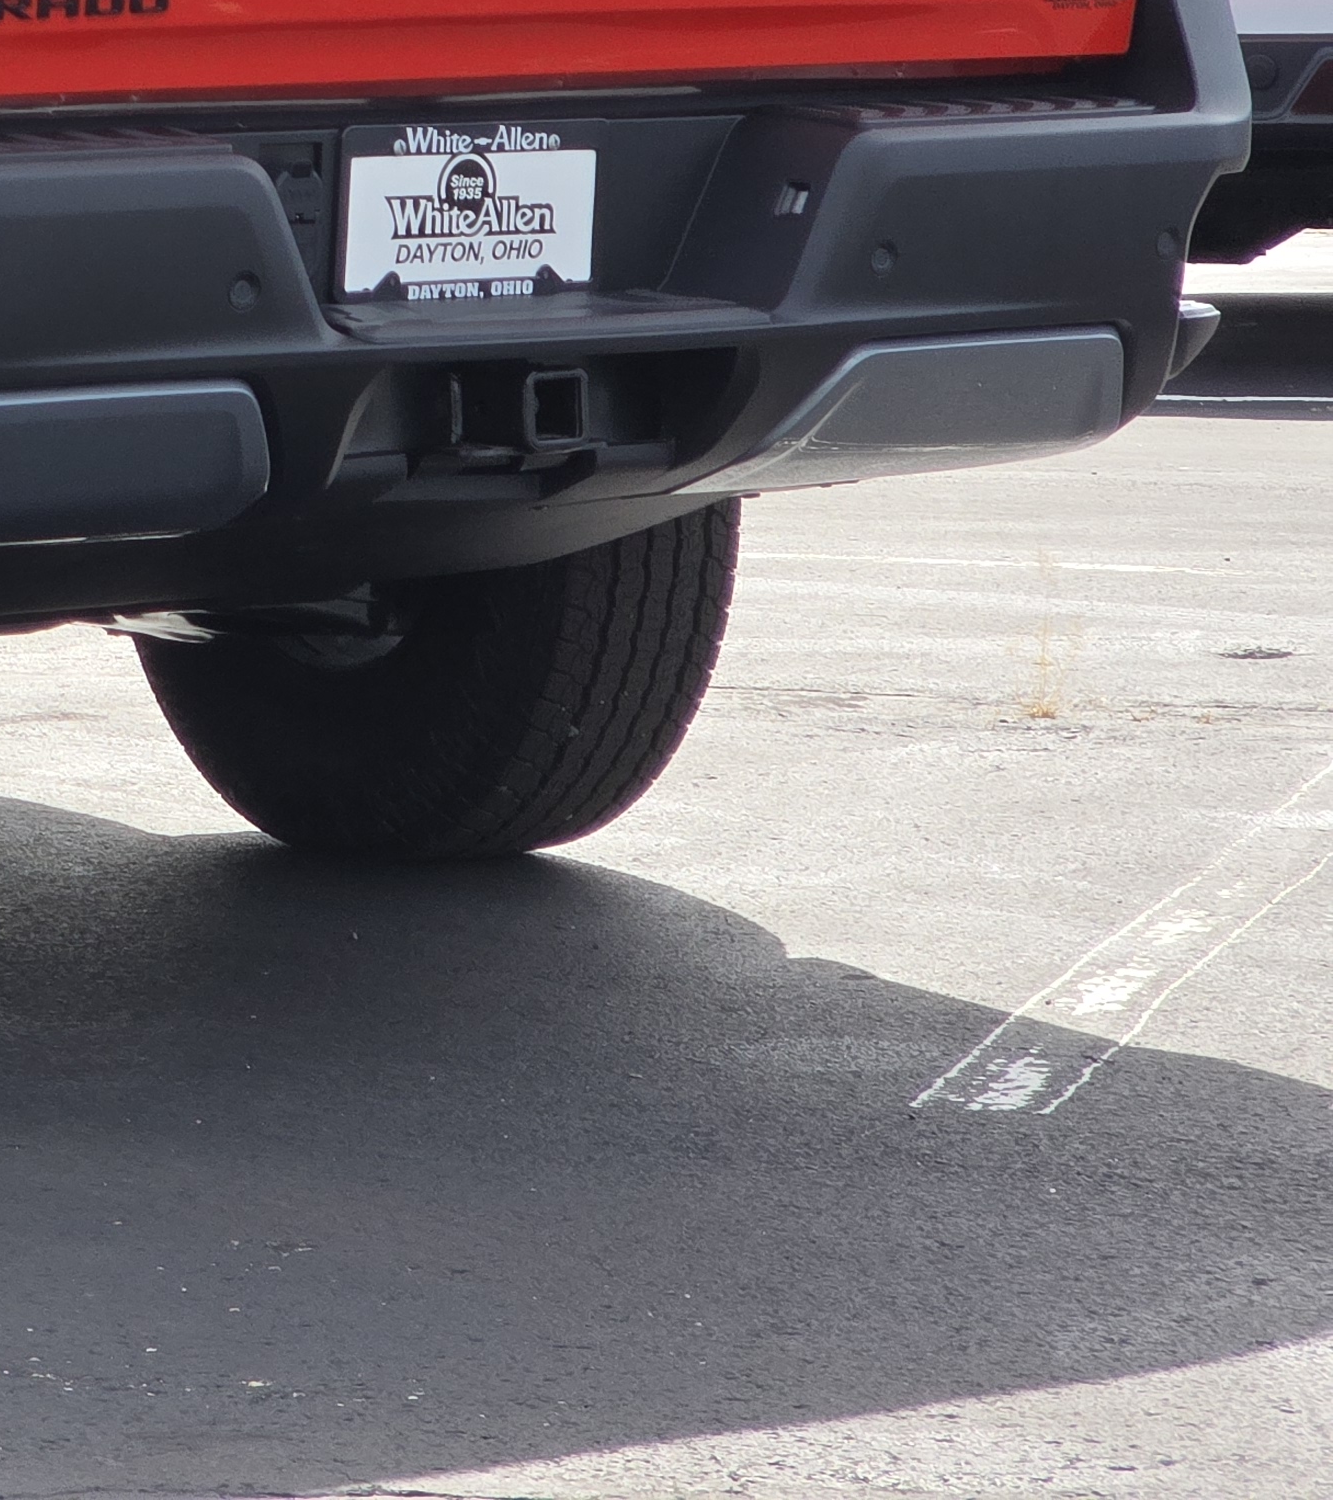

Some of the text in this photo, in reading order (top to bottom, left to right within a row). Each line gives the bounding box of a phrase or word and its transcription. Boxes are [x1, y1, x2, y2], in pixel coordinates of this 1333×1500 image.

[450, 174, 485, 188] Since
[453, 187, 482, 201] 1935
[395, 239, 544, 265] DAYTON, OHIO
[407, 279, 534, 301] DAYTON, OHIO
